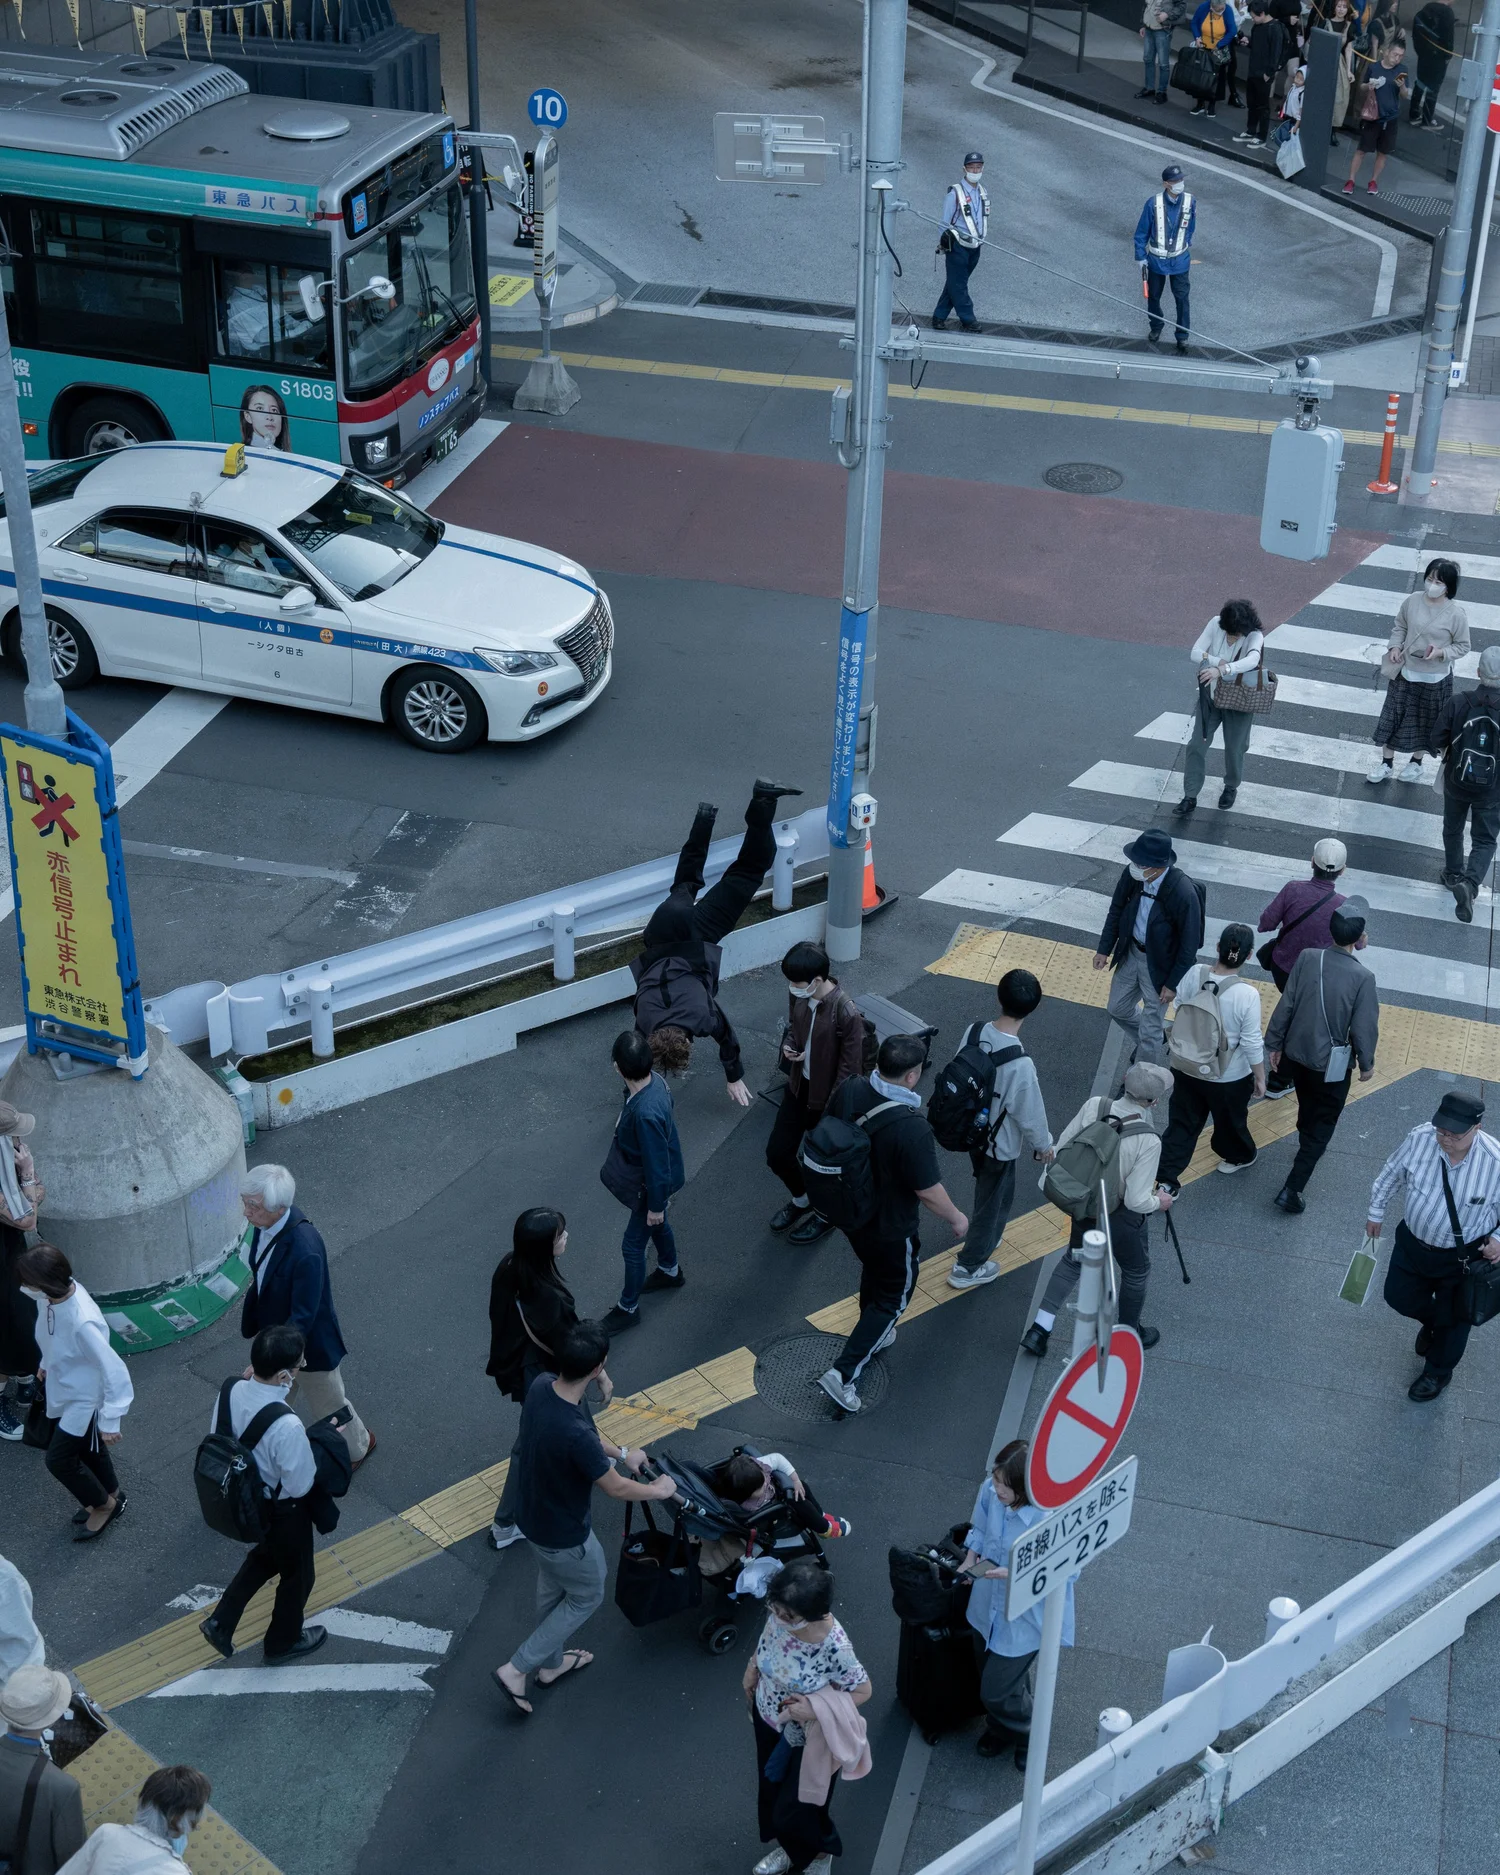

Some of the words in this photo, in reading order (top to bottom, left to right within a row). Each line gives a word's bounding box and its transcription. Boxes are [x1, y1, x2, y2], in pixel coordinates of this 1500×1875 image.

[533, 94, 562, 122] 10
[529, 174, 534, 184] NO
[212, 189, 301, 214] 東急バス
[280, 379, 334, 401] S1803
[419, 386, 460, 429] ノンステップバス
[274, 670, 281, 679] 6
[840, 641, 863, 777] 信号の表示が変わりました
[46, 850, 82, 988] 赤信号止まれ
[43, 984, 109, 1014] 東急株式会社
[44, 997, 110, 1027] 渋谷警察署
[1015, 1474, 1129, 1574] 路線バスを除く
